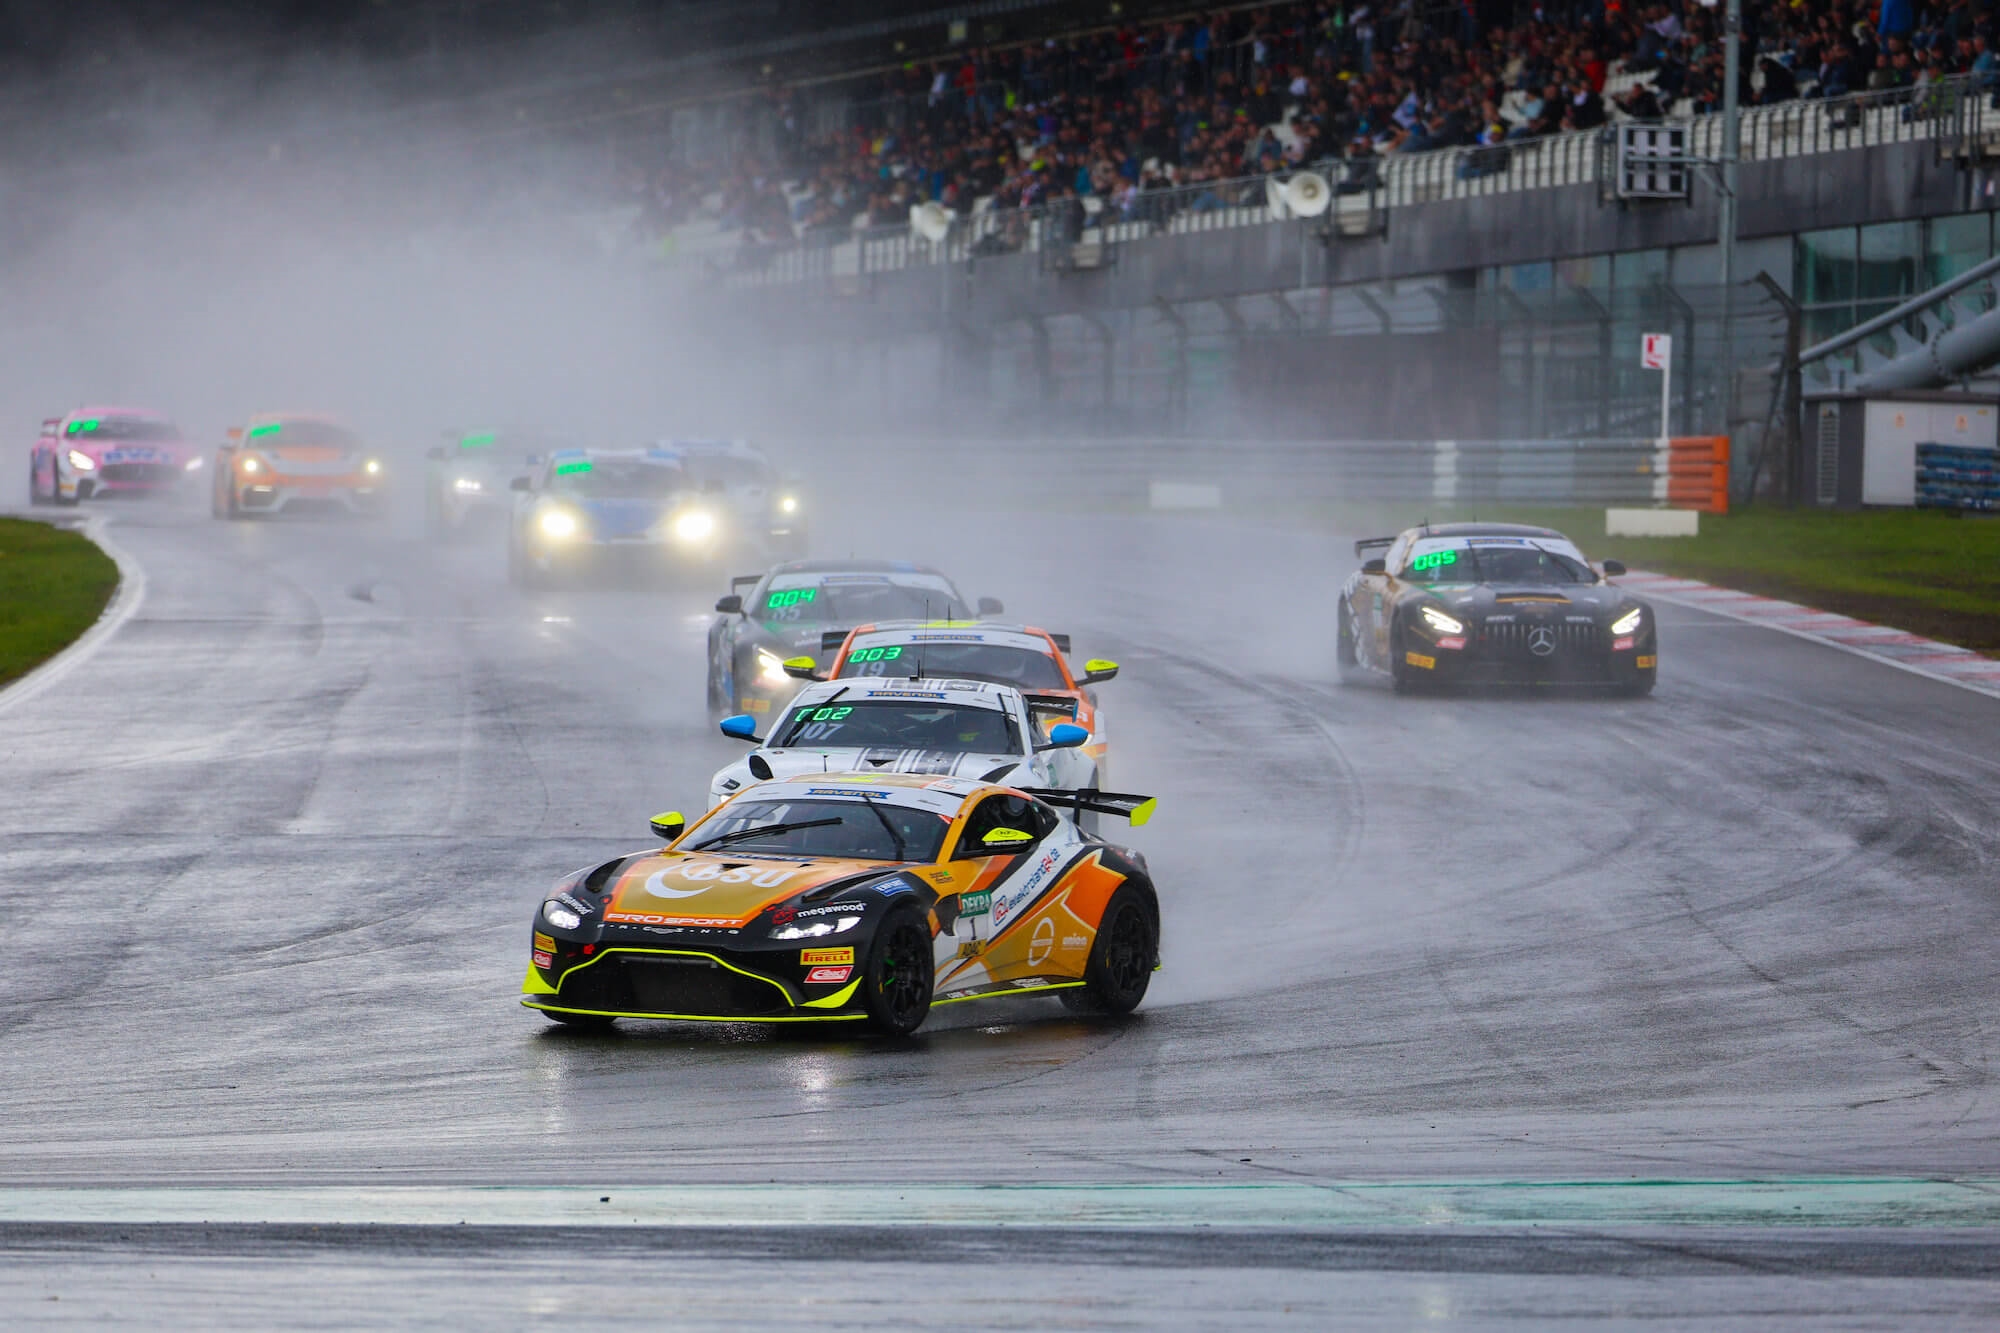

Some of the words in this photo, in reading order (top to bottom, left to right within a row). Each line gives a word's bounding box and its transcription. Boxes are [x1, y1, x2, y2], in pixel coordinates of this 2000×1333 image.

[1414, 550, 1457, 571] 005
[768, 589, 816, 609] 004
[849, 646, 902, 663] 003
[855, 662, 887, 677] 19
[872, 691, 941, 699] RAVENOL
[812, 789, 885, 798] RAVENOL
[797, 902, 865, 918] megawood
[962, 893, 991, 914] DEKRA
[607, 913, 664, 924] PRO
[663, 917, 744, 925] SPORT
[969, 917, 978, 940] 1
[803, 950, 851, 962] PIRELLI
